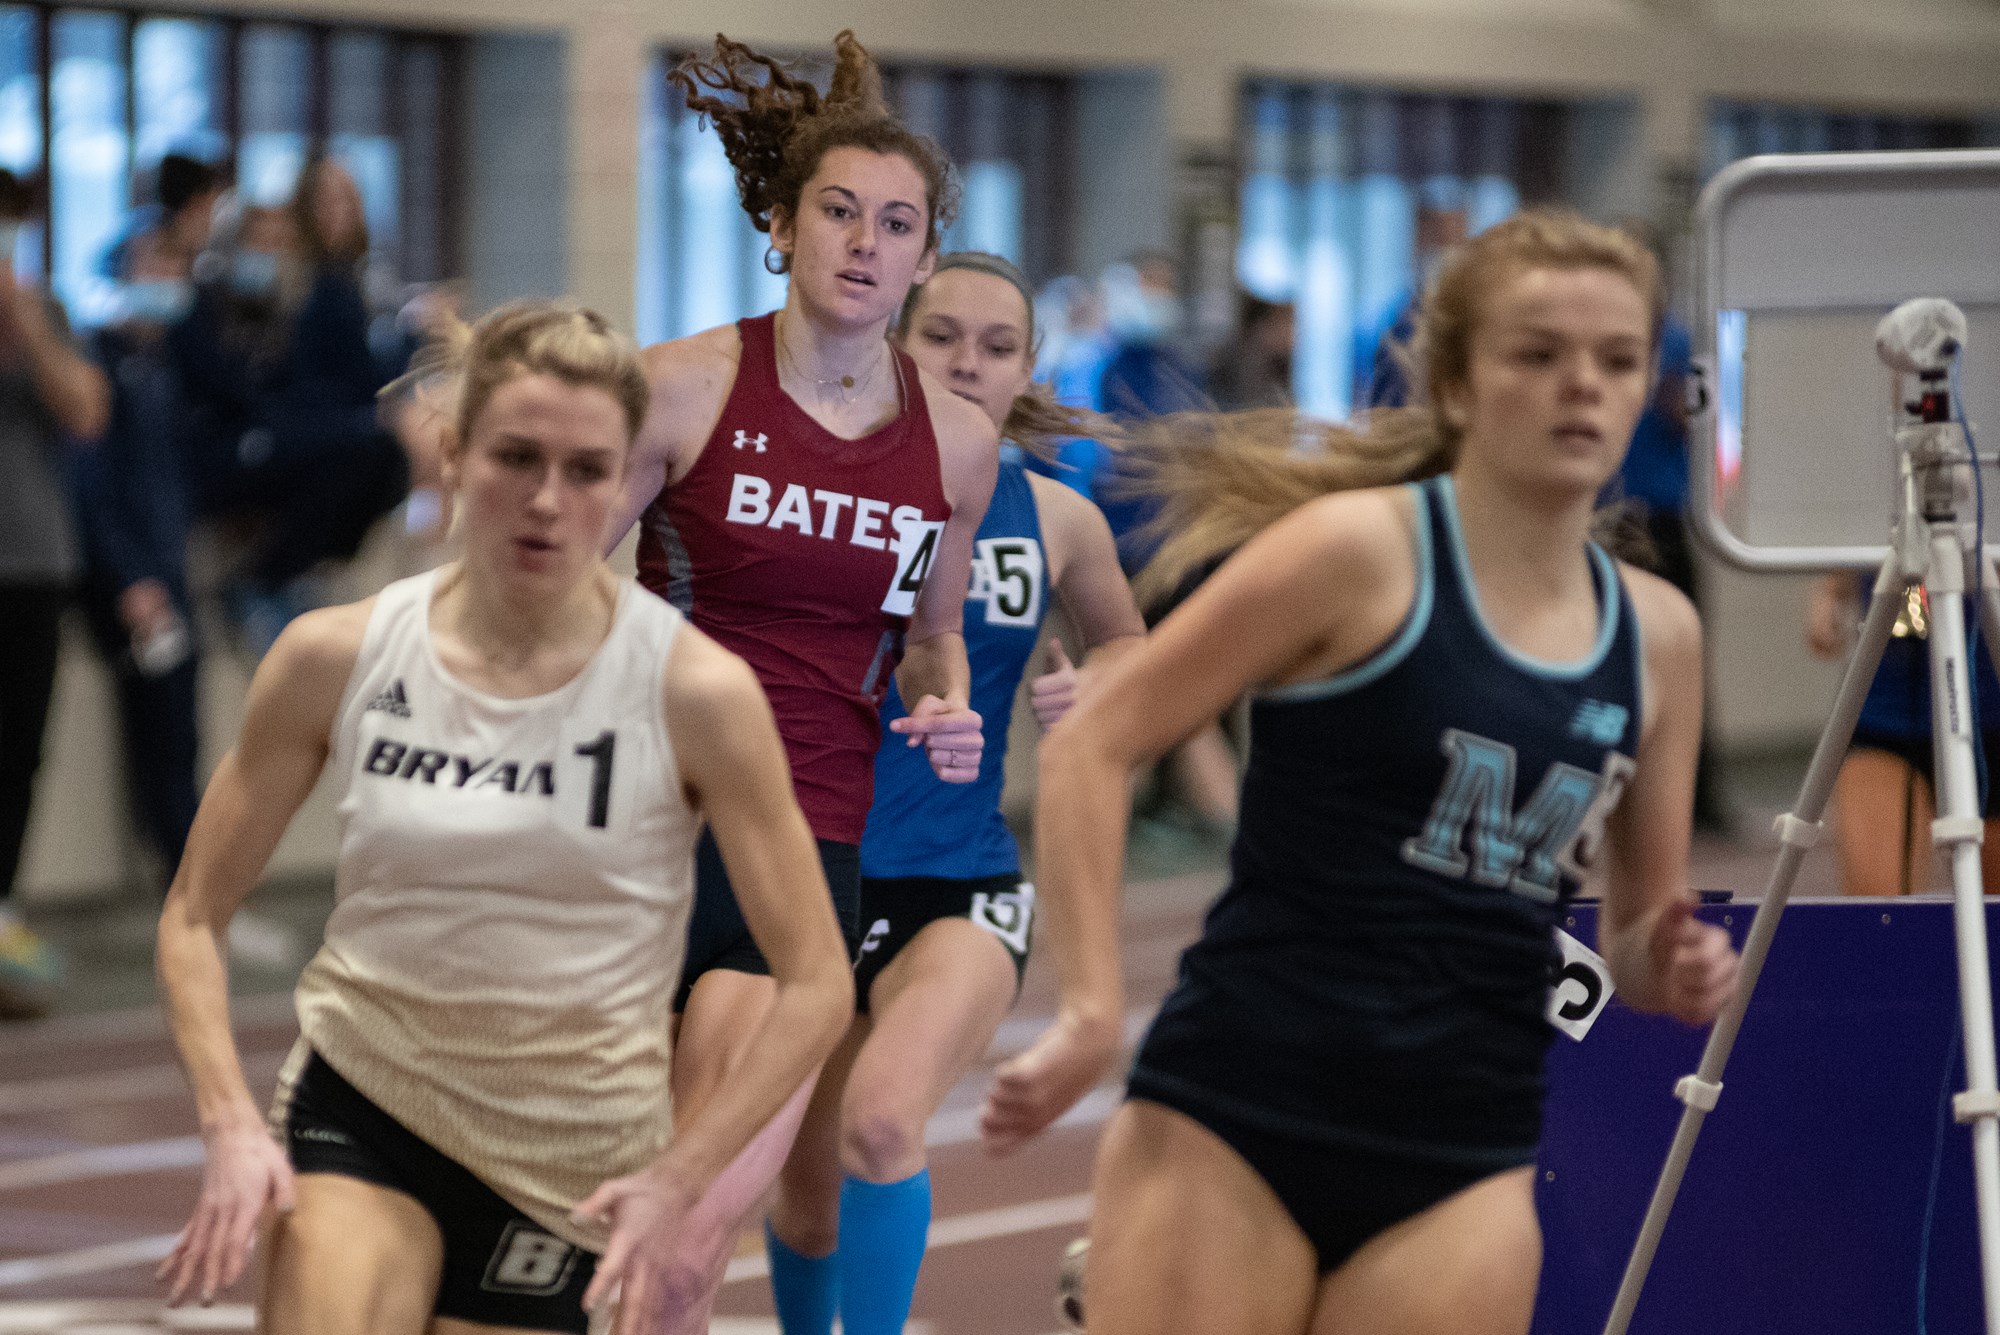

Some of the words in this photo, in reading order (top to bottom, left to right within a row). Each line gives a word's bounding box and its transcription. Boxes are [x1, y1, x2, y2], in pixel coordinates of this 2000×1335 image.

[897, 529, 938, 607] 4
[993, 544, 1032, 617] 5
[363, 737, 556, 796] BRYAN
[574, 729, 617, 829] 1
